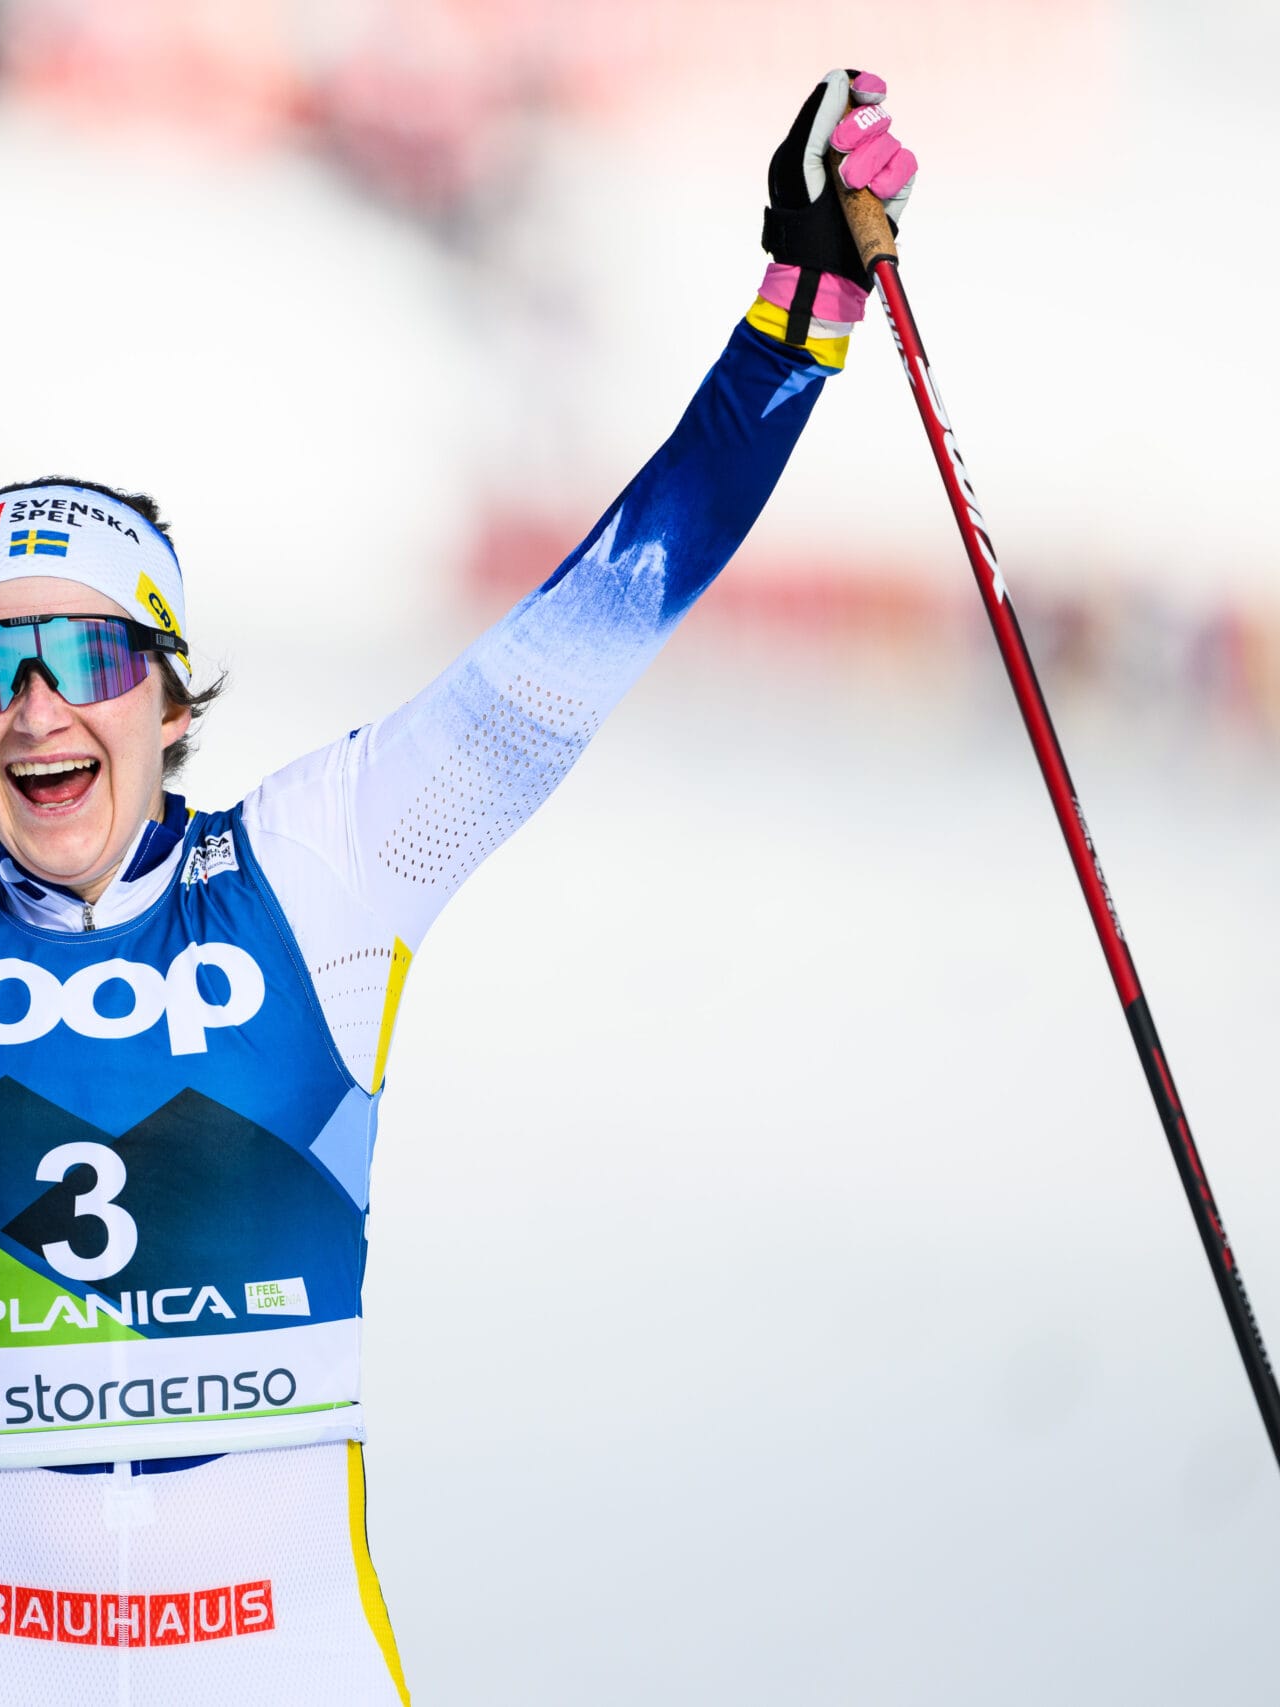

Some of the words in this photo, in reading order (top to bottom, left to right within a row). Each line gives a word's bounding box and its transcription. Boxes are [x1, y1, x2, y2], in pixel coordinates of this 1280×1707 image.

[9, 510, 82, 527] SPEL
[12, 499, 141, 545] SVENSKA
[148, 593, 175, 635] CR
[35, 1142, 138, 1281] 3
[256, 1283, 282, 1296] FEEL
